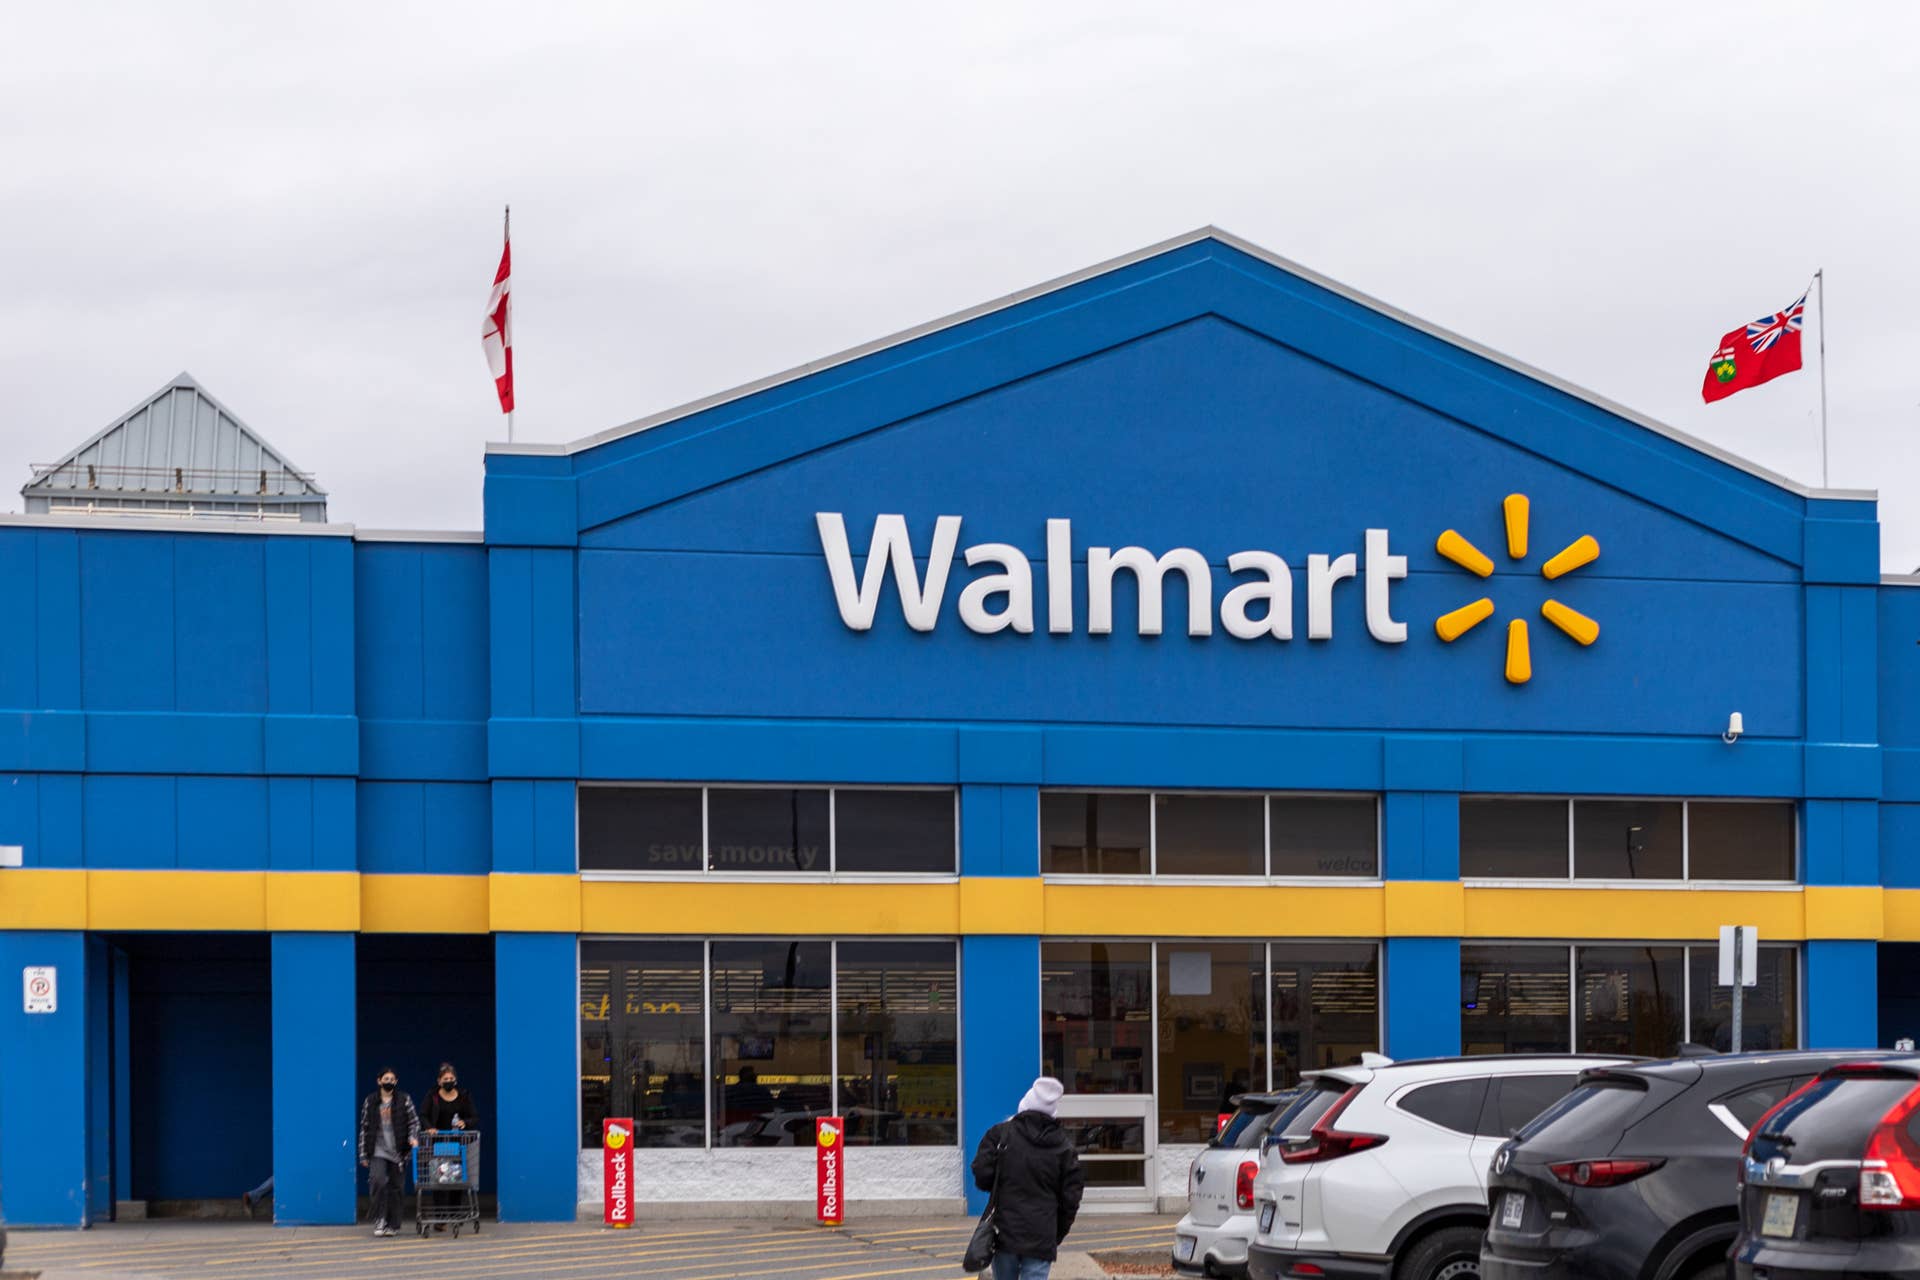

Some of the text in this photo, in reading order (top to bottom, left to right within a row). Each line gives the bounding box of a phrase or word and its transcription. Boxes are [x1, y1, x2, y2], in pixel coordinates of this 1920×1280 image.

[815, 511, 1408, 643] Walmart
[720, 845, 819, 870] money
[1317, 855, 1373, 872] welco
[611, 1152, 627, 1220] Rollback
[822, 1150, 837, 1217] Rollback
